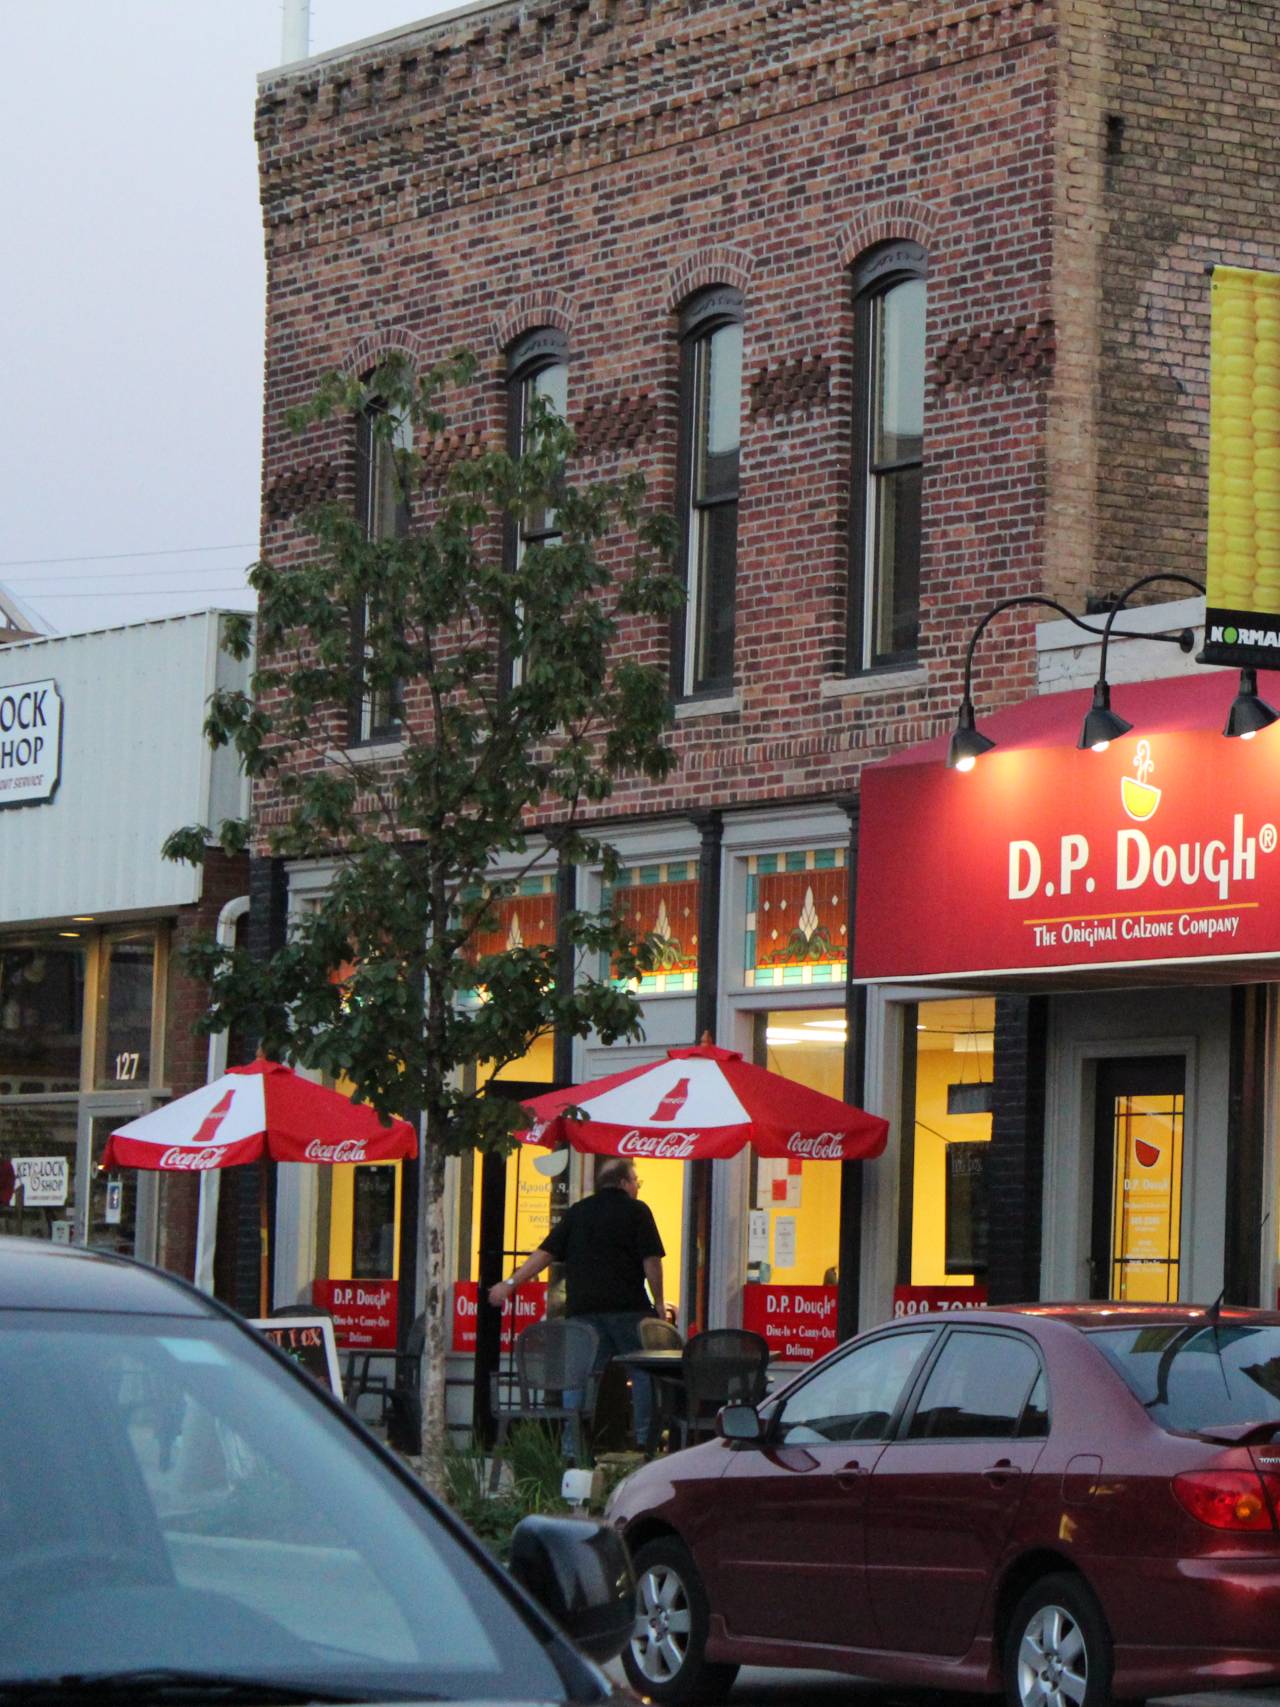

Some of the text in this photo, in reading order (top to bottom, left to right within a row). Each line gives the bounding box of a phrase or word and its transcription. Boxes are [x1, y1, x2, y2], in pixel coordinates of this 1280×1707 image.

[0, 689, 47, 732] OCK
[0, 736, 44, 769] HOP
[1008, 834, 1095, 900] D.P.
[1034, 914, 1240, 947] The Original Calzone Company
[115, 1052, 140, 1080] 127
[40, 1160, 64, 1177] LOCK
[41, 1179, 63, 1192] SHOP
[333, 1288, 354, 1305] D.P.
[766, 1295, 791, 1314] D.P.
